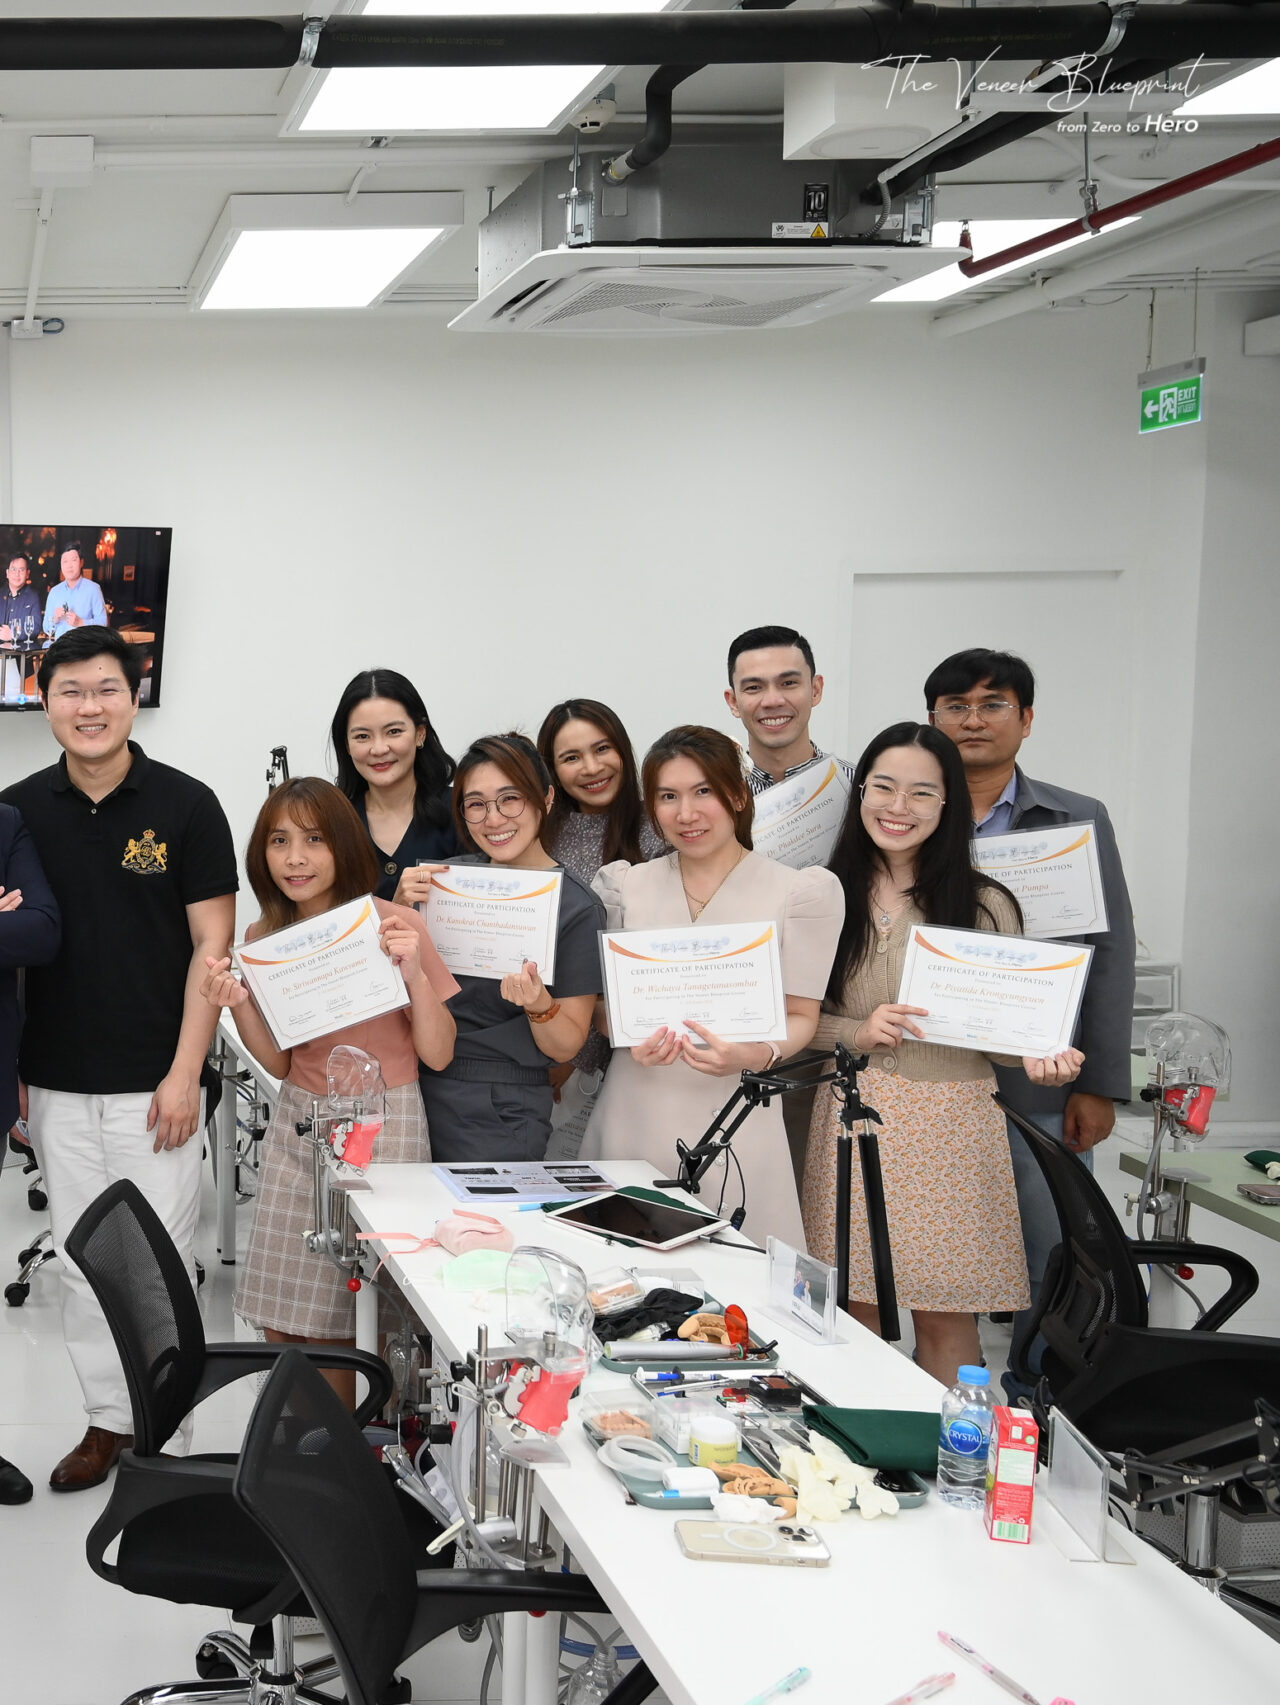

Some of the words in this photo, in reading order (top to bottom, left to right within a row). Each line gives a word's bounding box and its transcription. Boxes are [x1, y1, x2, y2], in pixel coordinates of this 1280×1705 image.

[808, 192, 825, 210] 10
[1177, 386, 1197, 401] EXIT
[776, 825, 785, 833] OF
[787, 797, 834, 827] PARTICIPATION
[1014, 863, 1073, 876] PARTICIPATION
[1022, 883, 1049, 894] Pumpa
[437, 899, 474, 909] CERTIFICATE
[486, 903, 536, 913] PARTICIPATION
[268, 961, 307, 981] CERTIFICATE
[307, 958, 316, 967] OF
[317, 938, 365, 962] PARTICIPATION
[630, 966, 679, 976] CERTIFICATE
[694, 961, 754, 972] PARTICIPATION
[927, 964, 976, 976] CERTIFICATE
[992, 972, 1054, 986] PARTICIPATION
[949, 1429, 980, 1443] CRYSTAL
